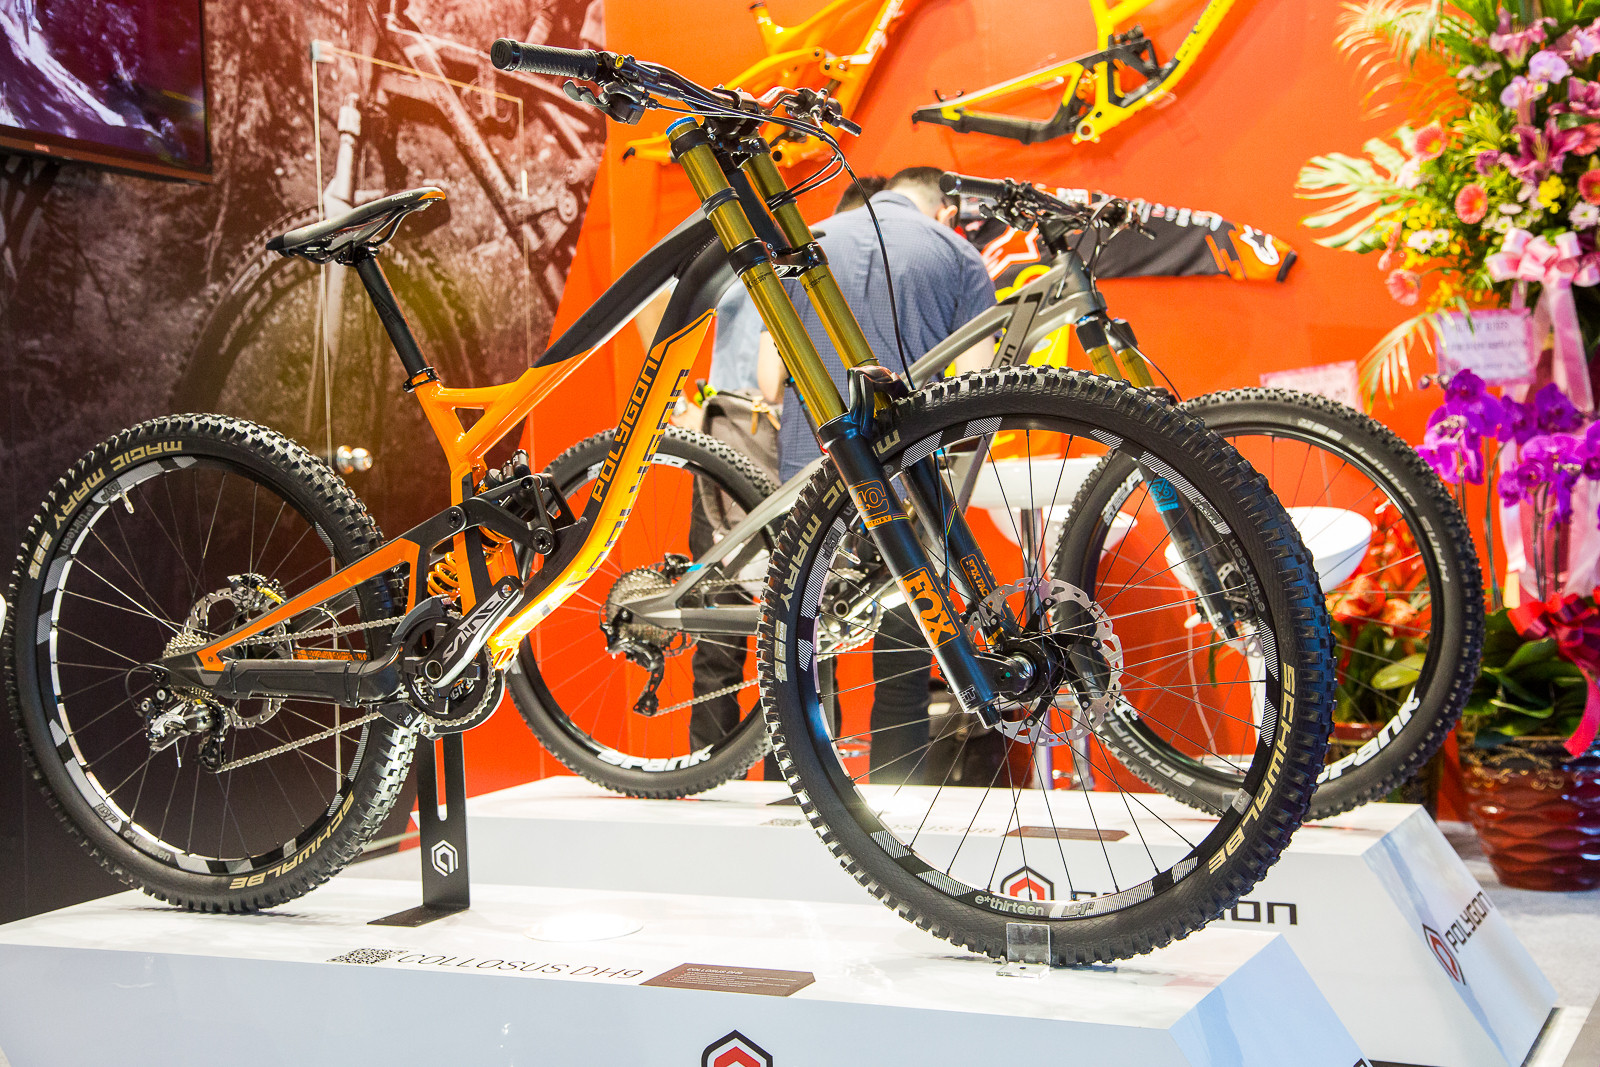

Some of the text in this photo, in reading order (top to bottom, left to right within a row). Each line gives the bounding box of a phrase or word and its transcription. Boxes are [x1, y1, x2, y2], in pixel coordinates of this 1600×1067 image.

[592, 357, 659, 502] POLYGON
[54, 440, 183, 530] MAGIC MARY
[780, 513, 823, 612] MARY
[966, 558, 983, 583] FOX
[902, 570, 957, 646] FOX
[1208, 662, 1295, 875] SCHWALBE
[228, 790, 355, 890] SCHWALBE
[397, 953, 644, 979] COLLOSUS DH9
[1445, 891, 1493, 953] POLYGON
